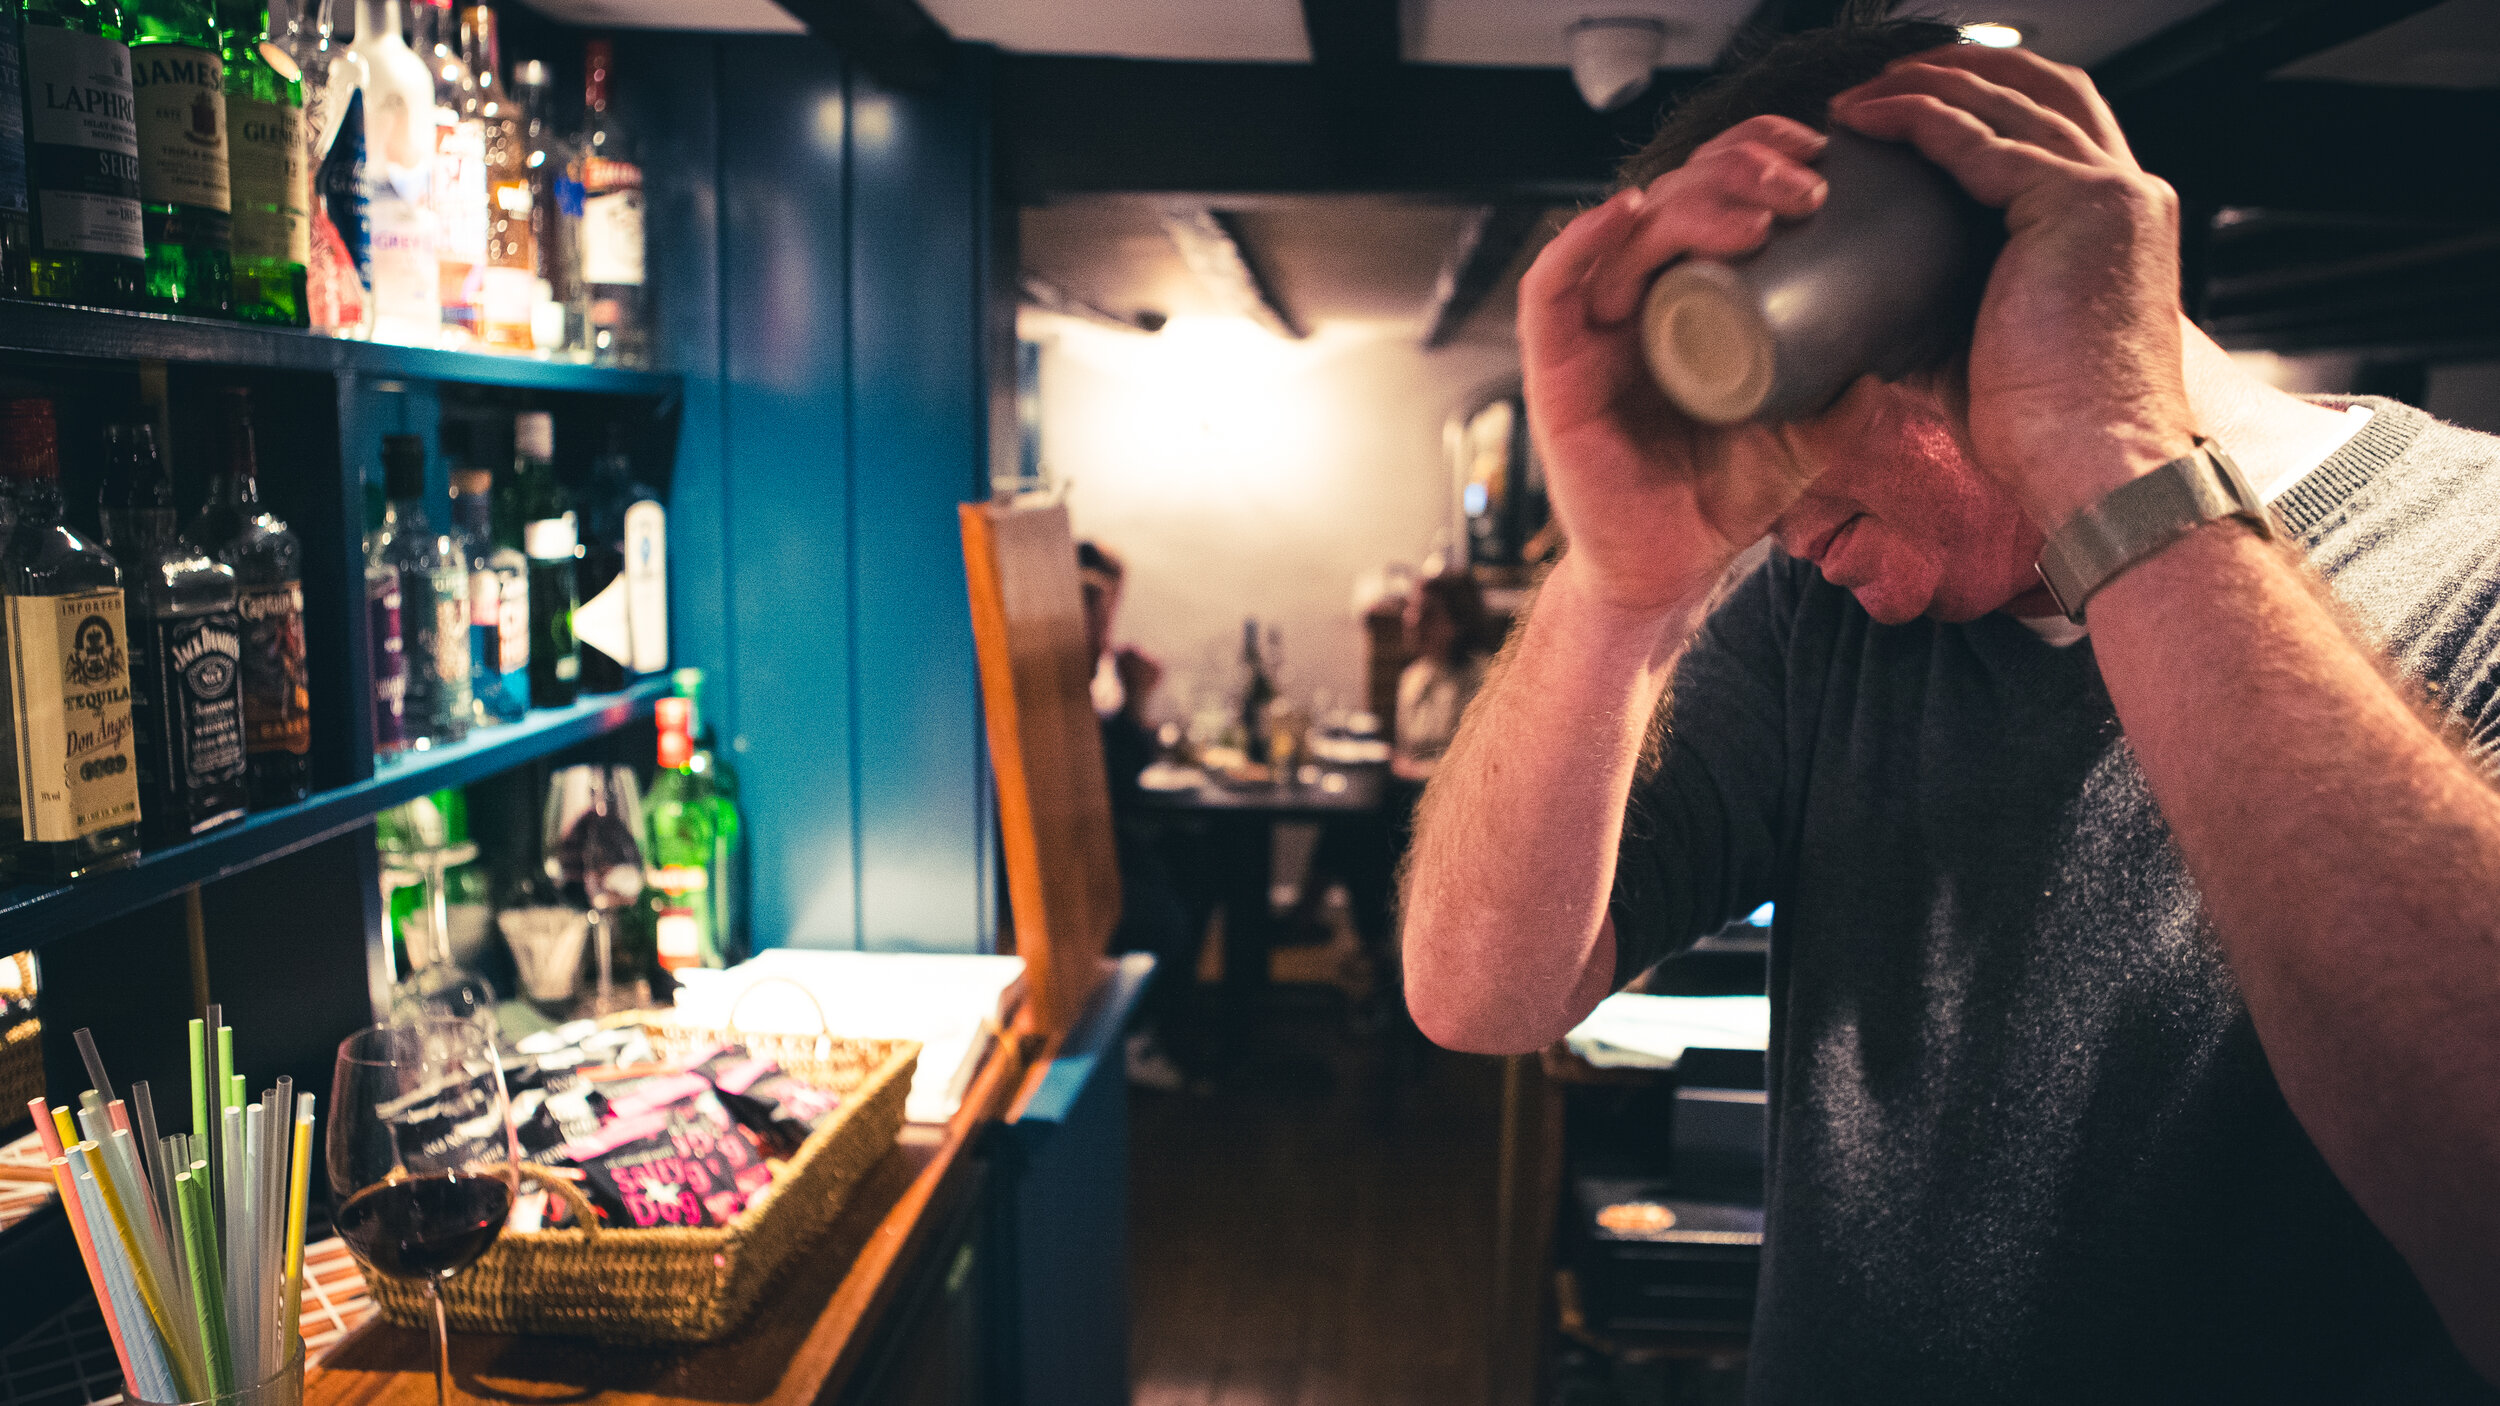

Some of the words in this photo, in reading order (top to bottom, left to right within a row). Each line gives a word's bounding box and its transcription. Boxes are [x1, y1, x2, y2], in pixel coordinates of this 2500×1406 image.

[61, 597, 121, 616] IMPORTED
[63, 685, 130, 712] TEQUILA
[66, 729, 94, 758] Don
